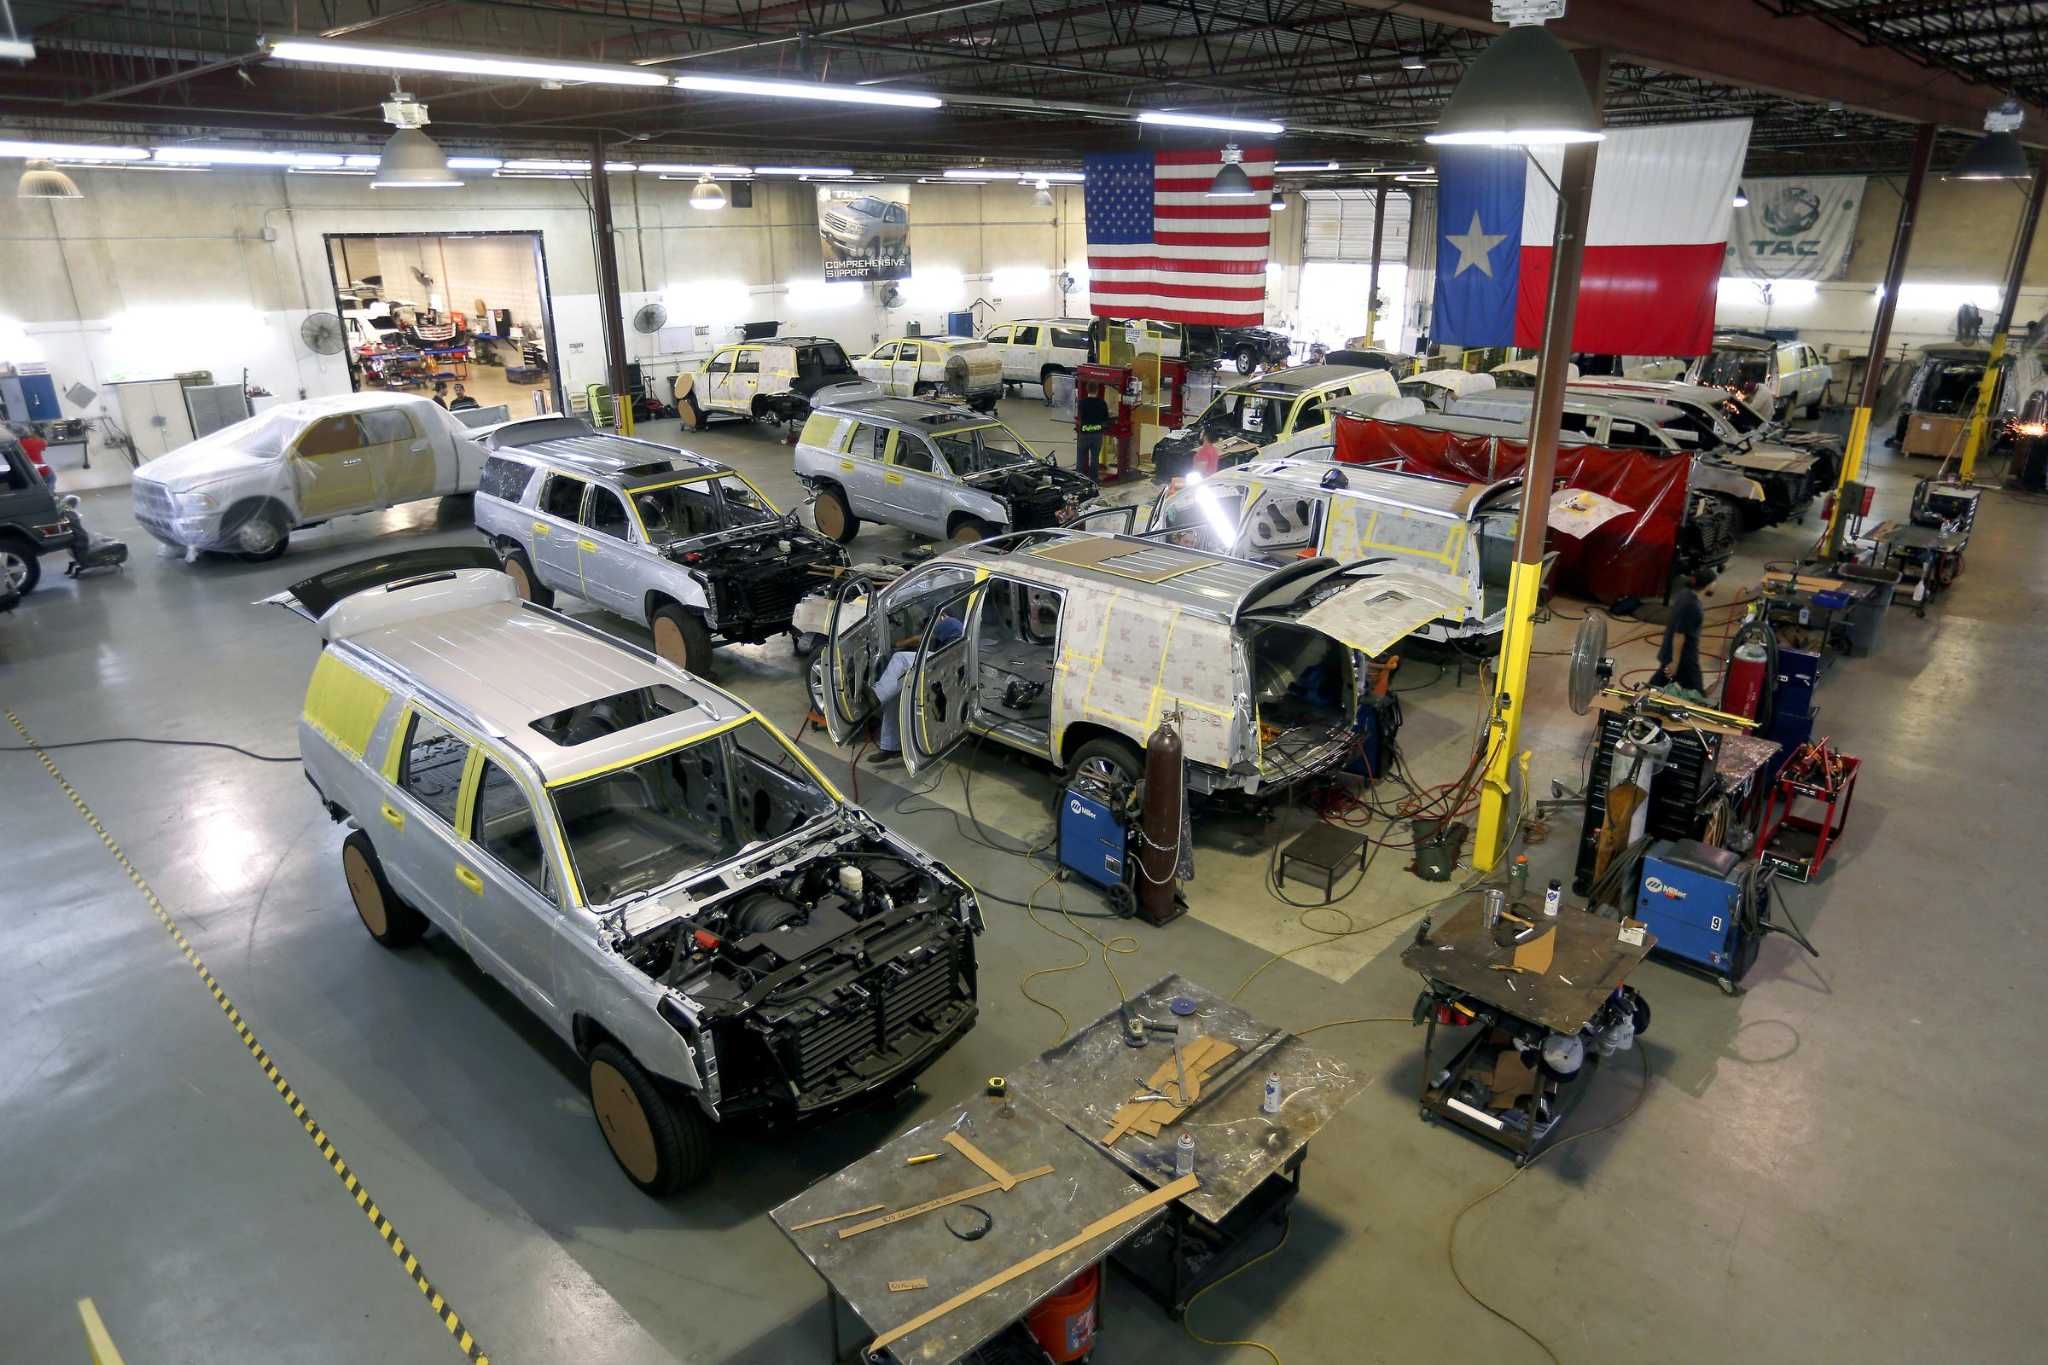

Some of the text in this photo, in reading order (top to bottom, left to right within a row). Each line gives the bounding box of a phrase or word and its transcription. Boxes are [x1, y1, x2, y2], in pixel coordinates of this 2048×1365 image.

[1750, 240, 1821, 256] TAC
[825, 258, 906, 269] COMPREHENSIVE
[826, 269, 870, 278] SUPPORT
[1713, 918, 1720, 929] 9
